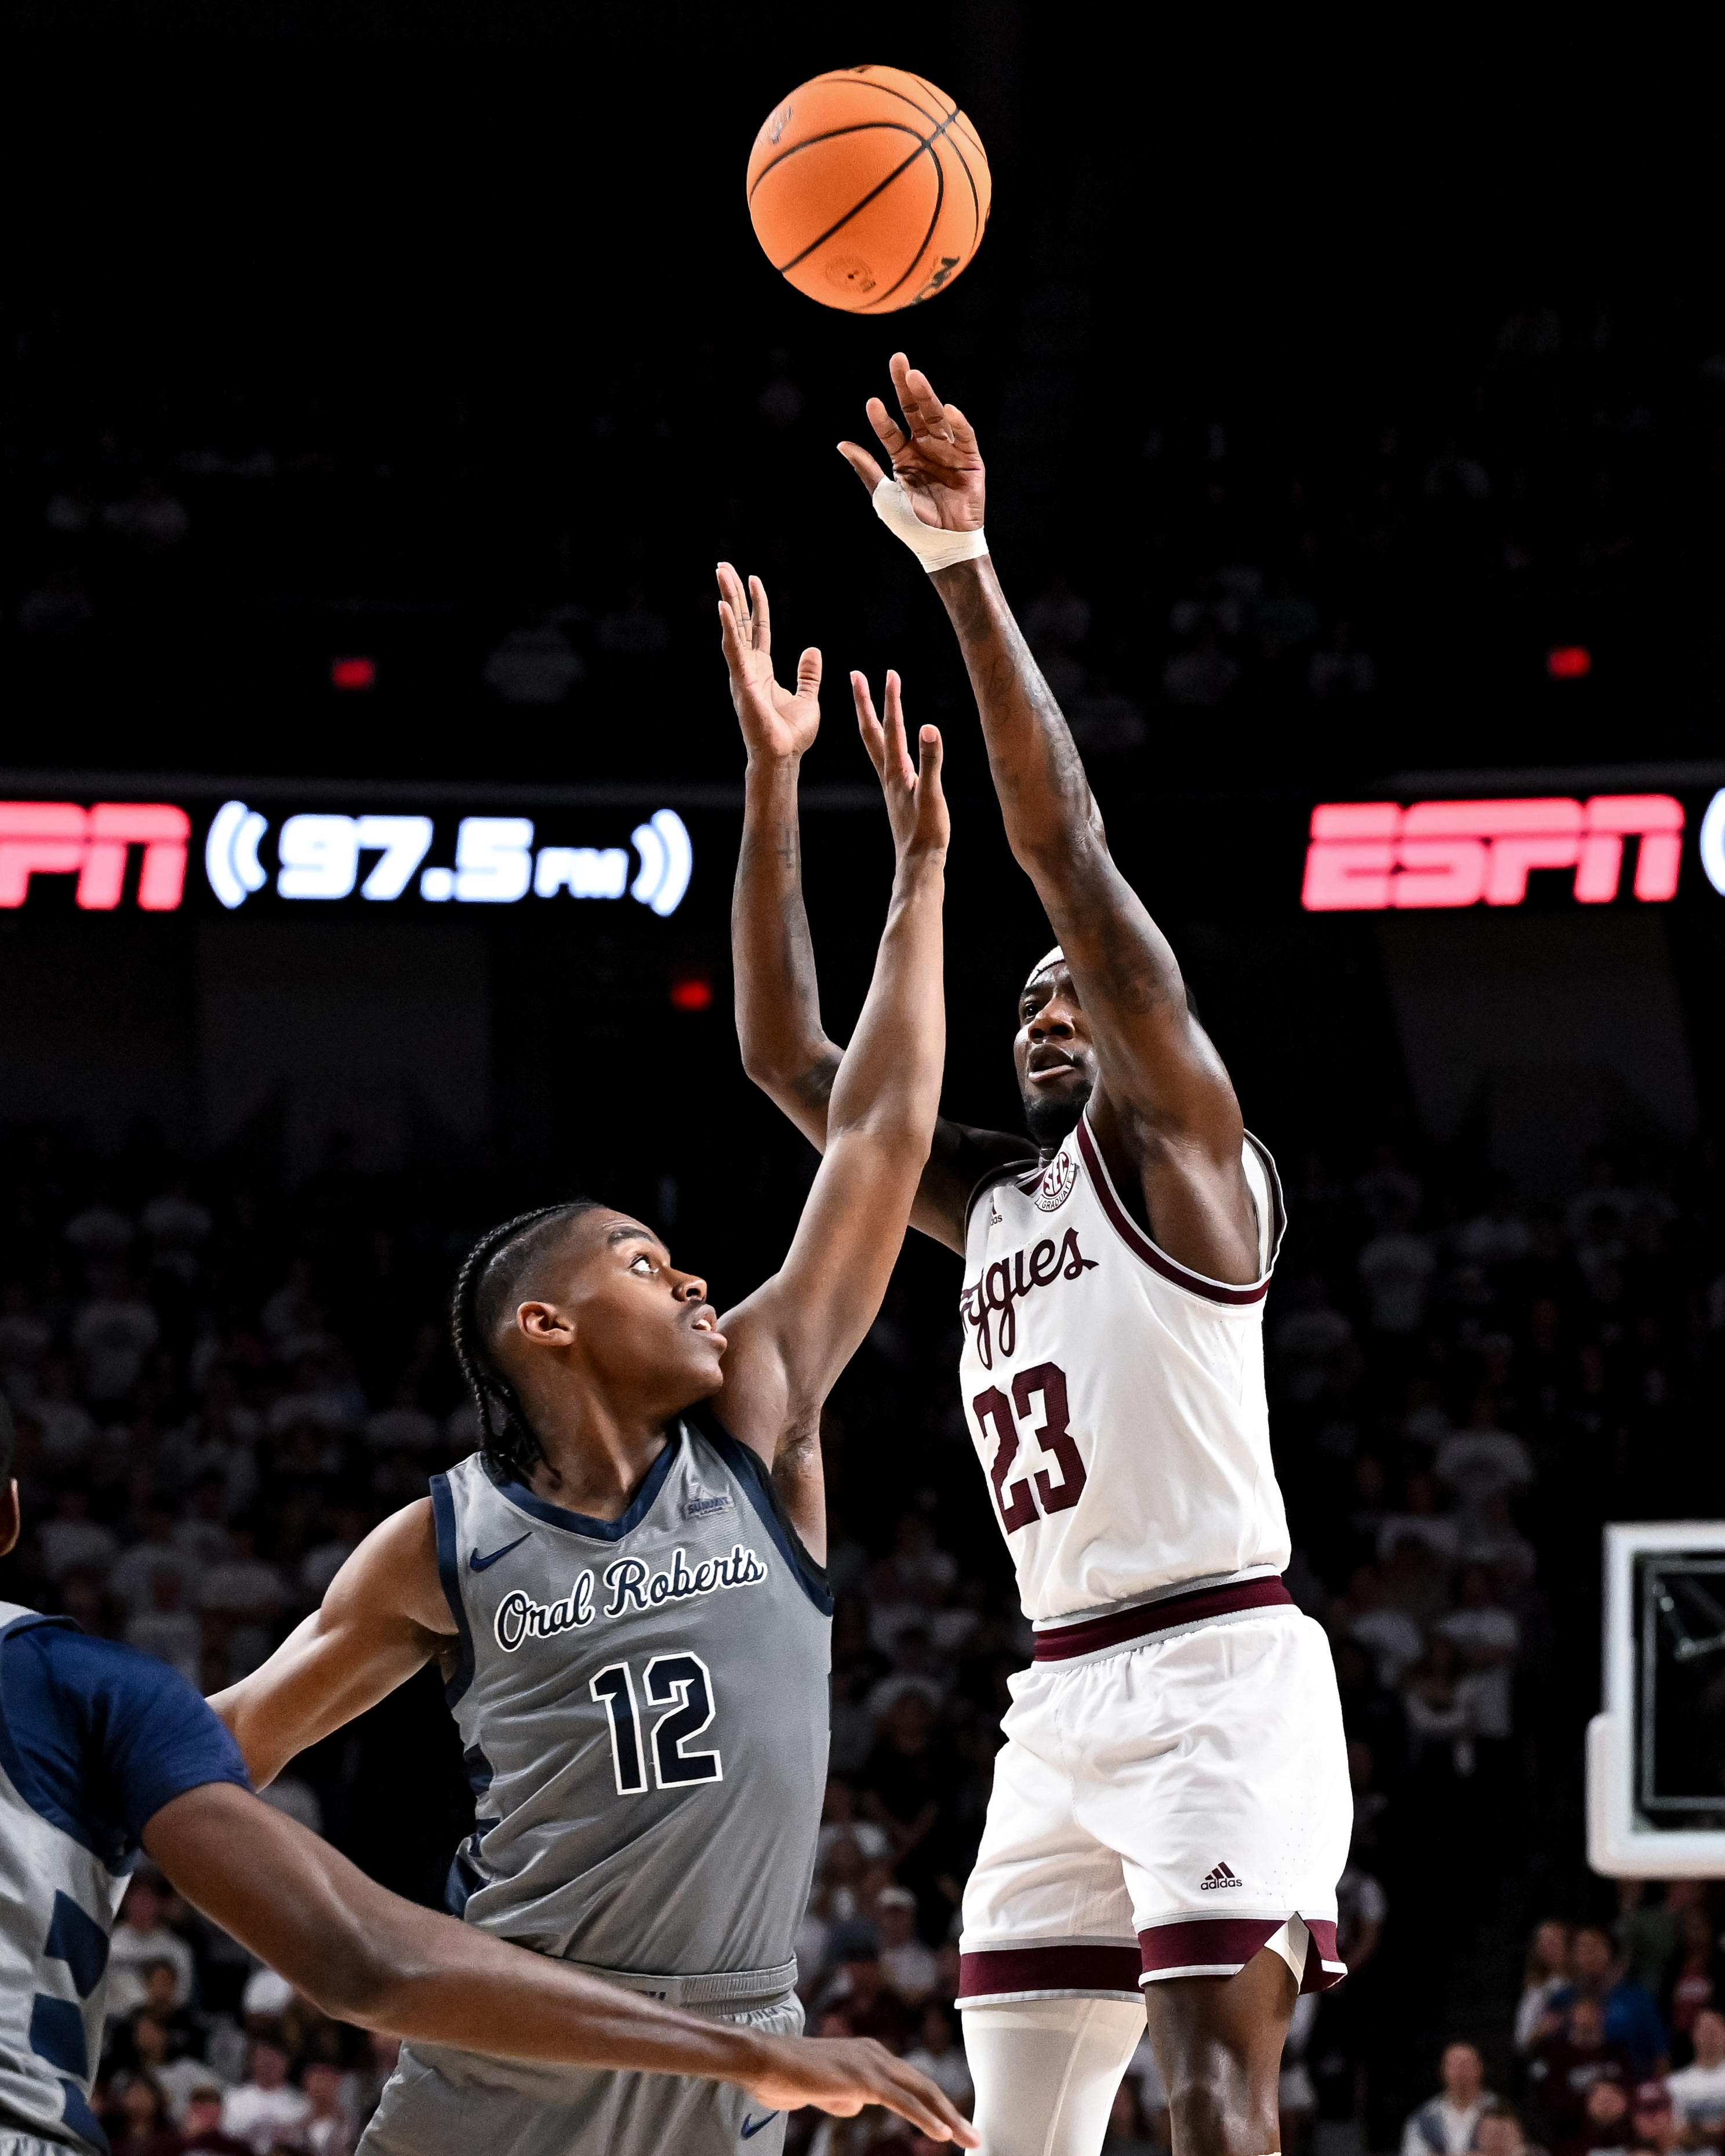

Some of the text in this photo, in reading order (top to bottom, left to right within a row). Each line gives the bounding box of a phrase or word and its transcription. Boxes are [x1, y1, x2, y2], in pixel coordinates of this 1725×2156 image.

[0, 802, 190, 911] PN
[277, 814, 534, 903] 97.5
[1301, 794, 1684, 911] ESPN
[1041, 1177, 1073, 1209] GRADUATE
[1044, 1151, 1069, 1195] SEC
[960, 1227, 1099, 1370] ggies
[972, 1361, 1087, 1535] 23
[494, 1544, 768, 1652] Oral Roberts
[589, 1651, 723, 1795] 12
[1200, 1878, 1243, 1890] adidas
